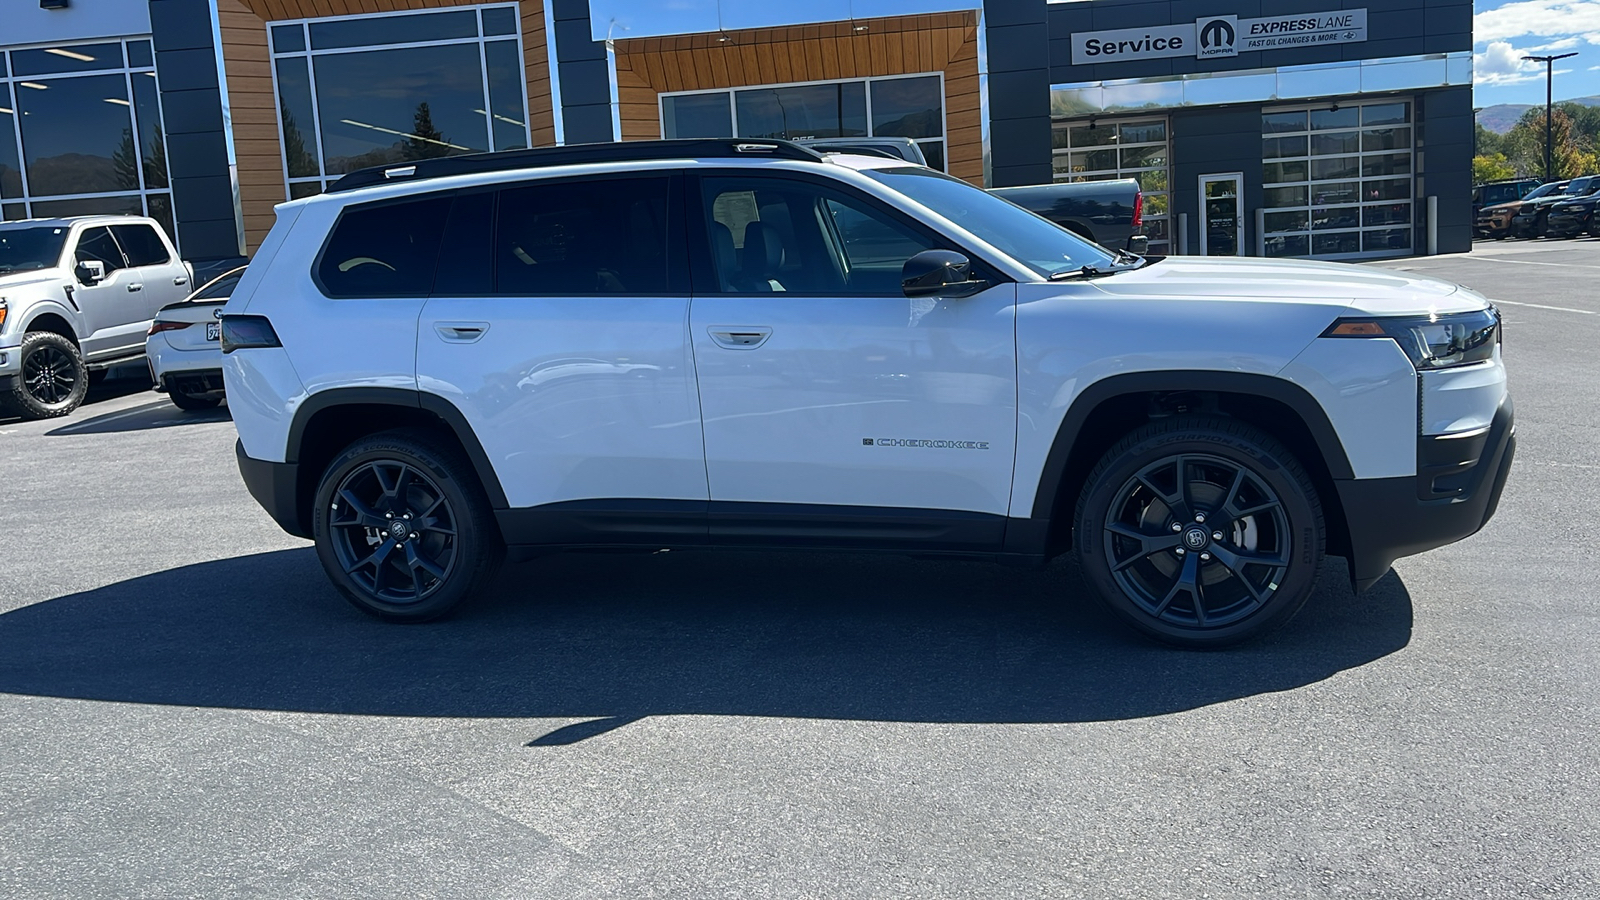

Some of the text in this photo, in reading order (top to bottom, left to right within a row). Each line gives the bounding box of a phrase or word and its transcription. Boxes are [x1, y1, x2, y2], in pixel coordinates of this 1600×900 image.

[1085, 35, 1183, 56] Service
[1248, 39, 1265, 48] FAST
[1266, 38, 1276, 46] OIL
[1278, 36, 1310, 45] CHANGES
[1318, 33, 1338, 41] MORE
[877, 438, 990, 449] CHEROKEE
